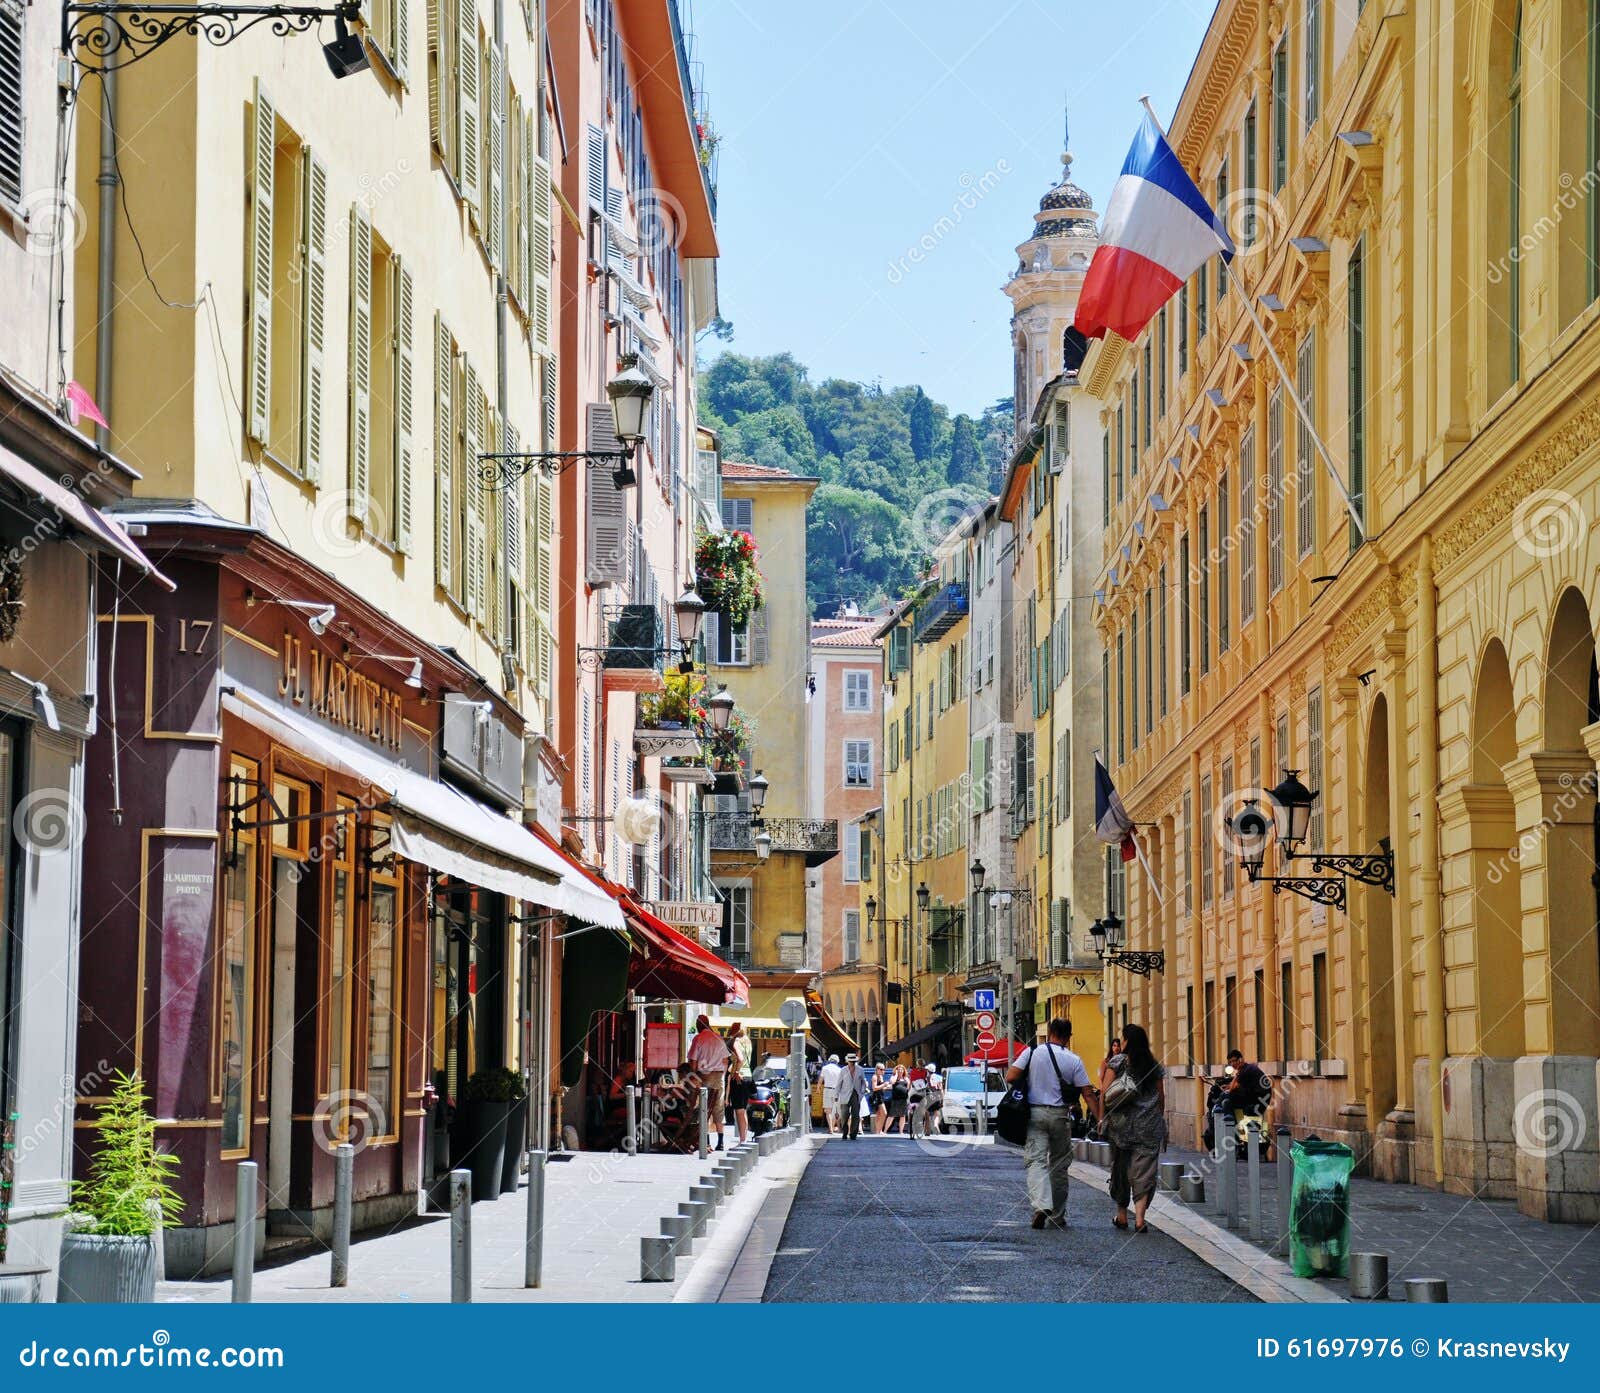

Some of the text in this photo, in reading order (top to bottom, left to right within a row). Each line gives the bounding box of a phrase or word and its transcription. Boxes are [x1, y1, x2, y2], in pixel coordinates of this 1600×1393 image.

[178, 618, 213, 654] 17
[176, 885, 201, 895] PHOTO
[658, 905, 718, 923] TOILETTAGE
